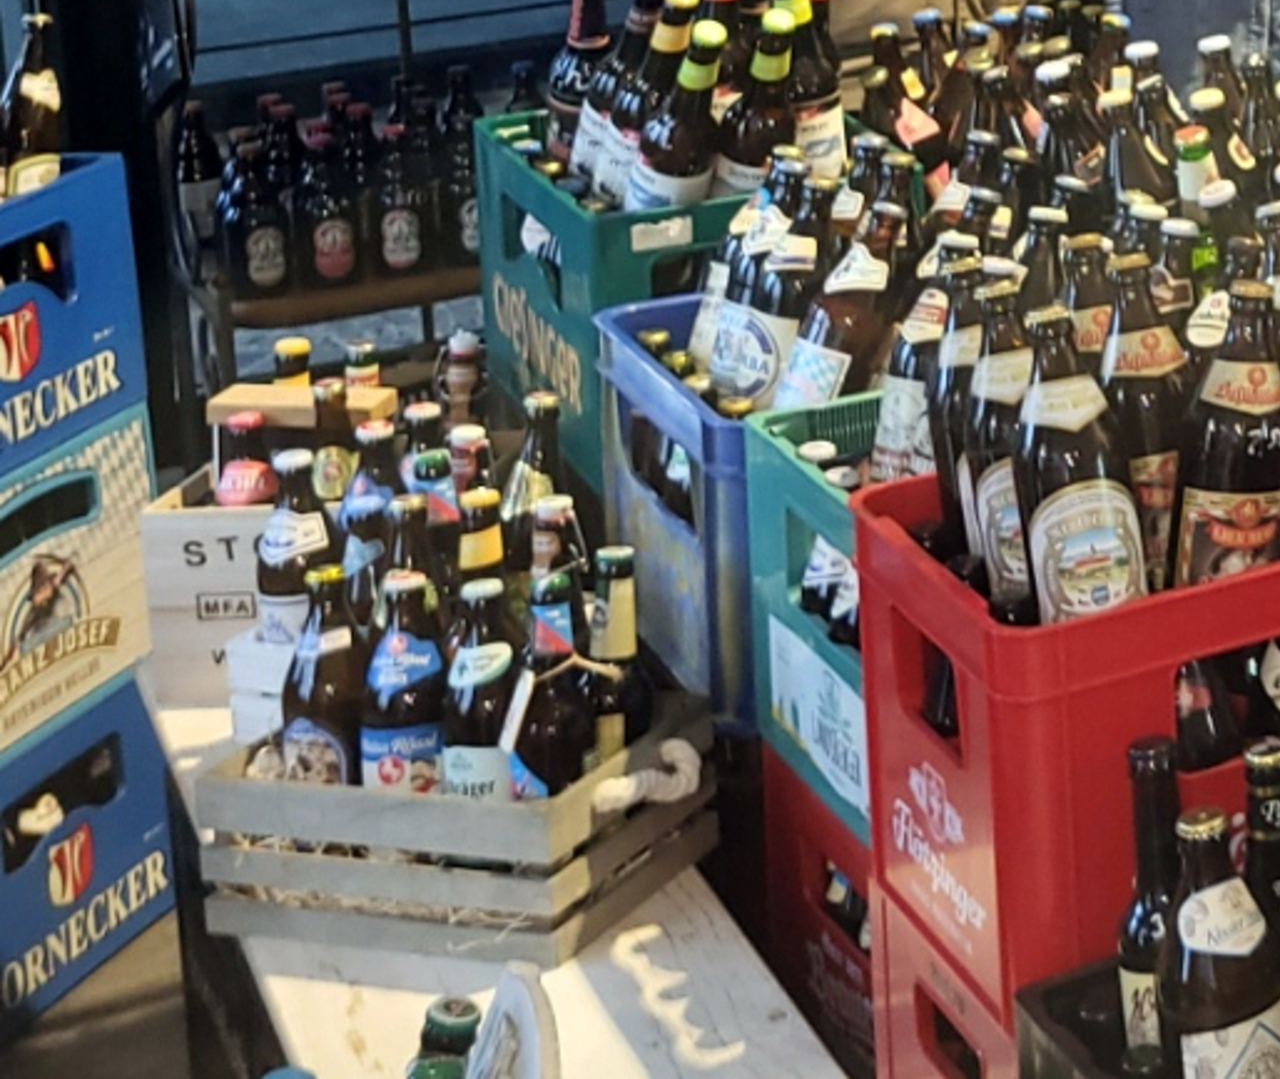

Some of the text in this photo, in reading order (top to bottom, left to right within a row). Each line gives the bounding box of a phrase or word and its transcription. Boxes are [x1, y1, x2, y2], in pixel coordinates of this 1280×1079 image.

[0, 347, 122, 445] NECKER
[54, 618, 112, 657] JOSEF
[2, 847, 170, 1009] ORNECKER
